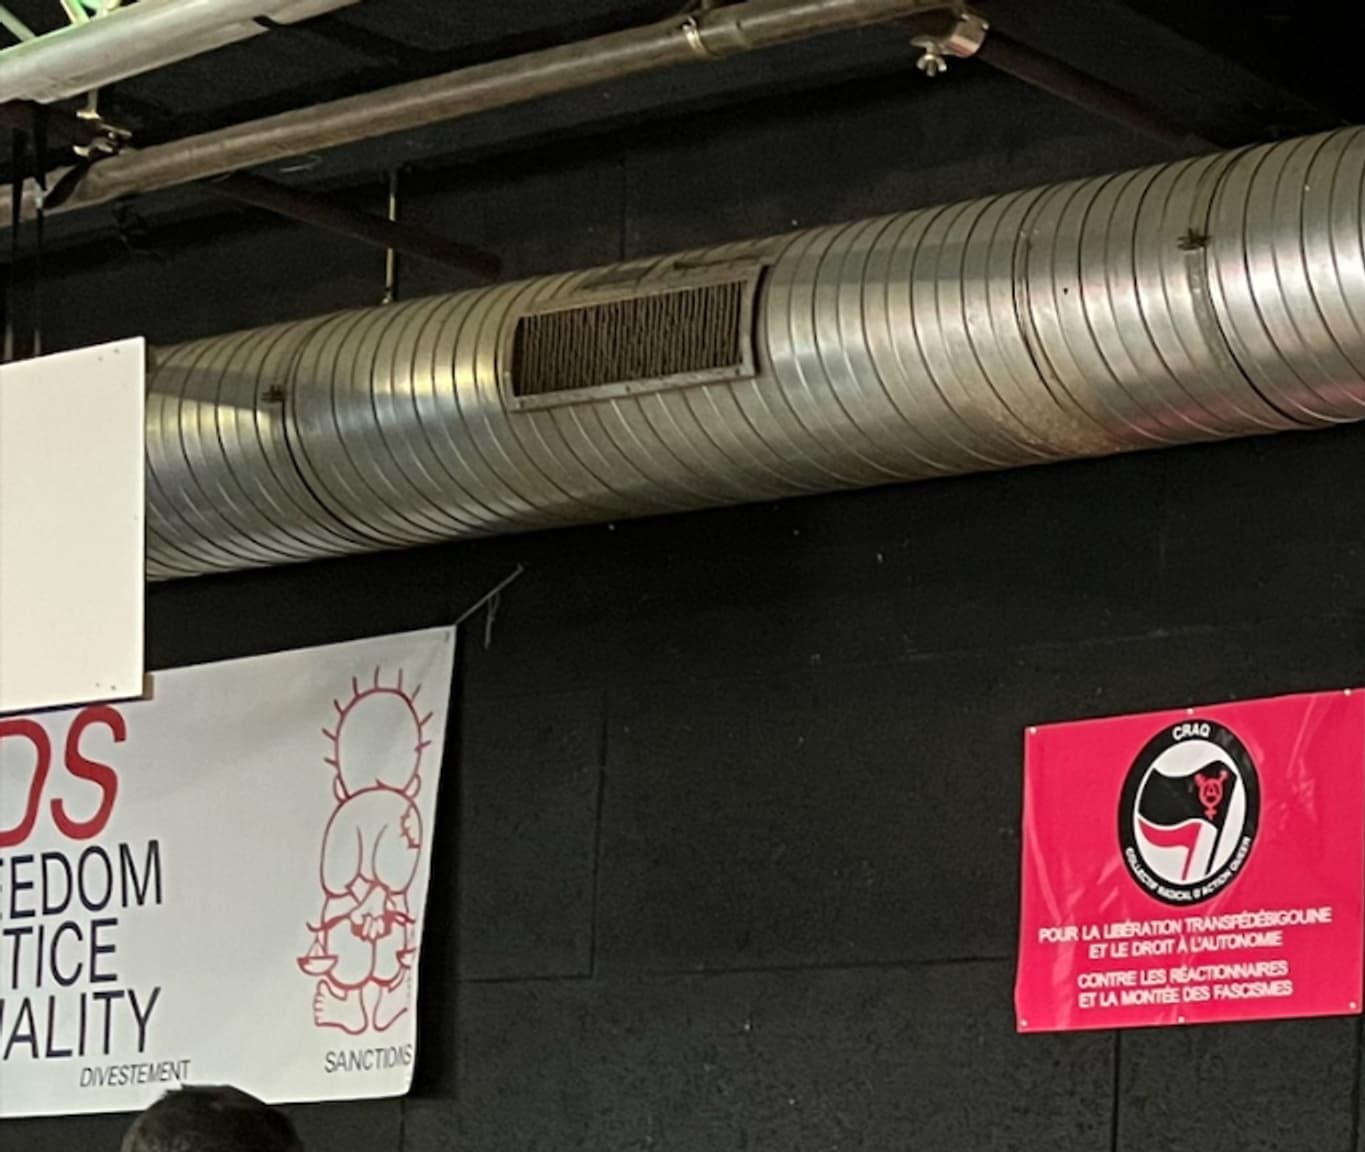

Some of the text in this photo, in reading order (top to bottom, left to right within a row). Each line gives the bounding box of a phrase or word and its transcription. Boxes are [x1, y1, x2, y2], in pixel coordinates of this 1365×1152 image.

[1172, 723, 1210, 740] CRAQ
[0, 840, 162, 920] EDOM
[1039, 925, 1078, 943] POUR
[1082, 925, 1100, 941] LA
[1089, 944, 1108, 959] ET
[1111, 943, 1129, 958] LE
[1132, 939, 1174, 956] DROIT
[1078, 971, 1137, 989] CONTRE
[1140, 969, 1167, 986] LES
[1078, 980, 1293, 1008] ET LA MONTÉE DES FASCISMES
[0, 987, 160, 1060] ALITY
[80, 1060, 190, 1088] DIVESTEMENT
